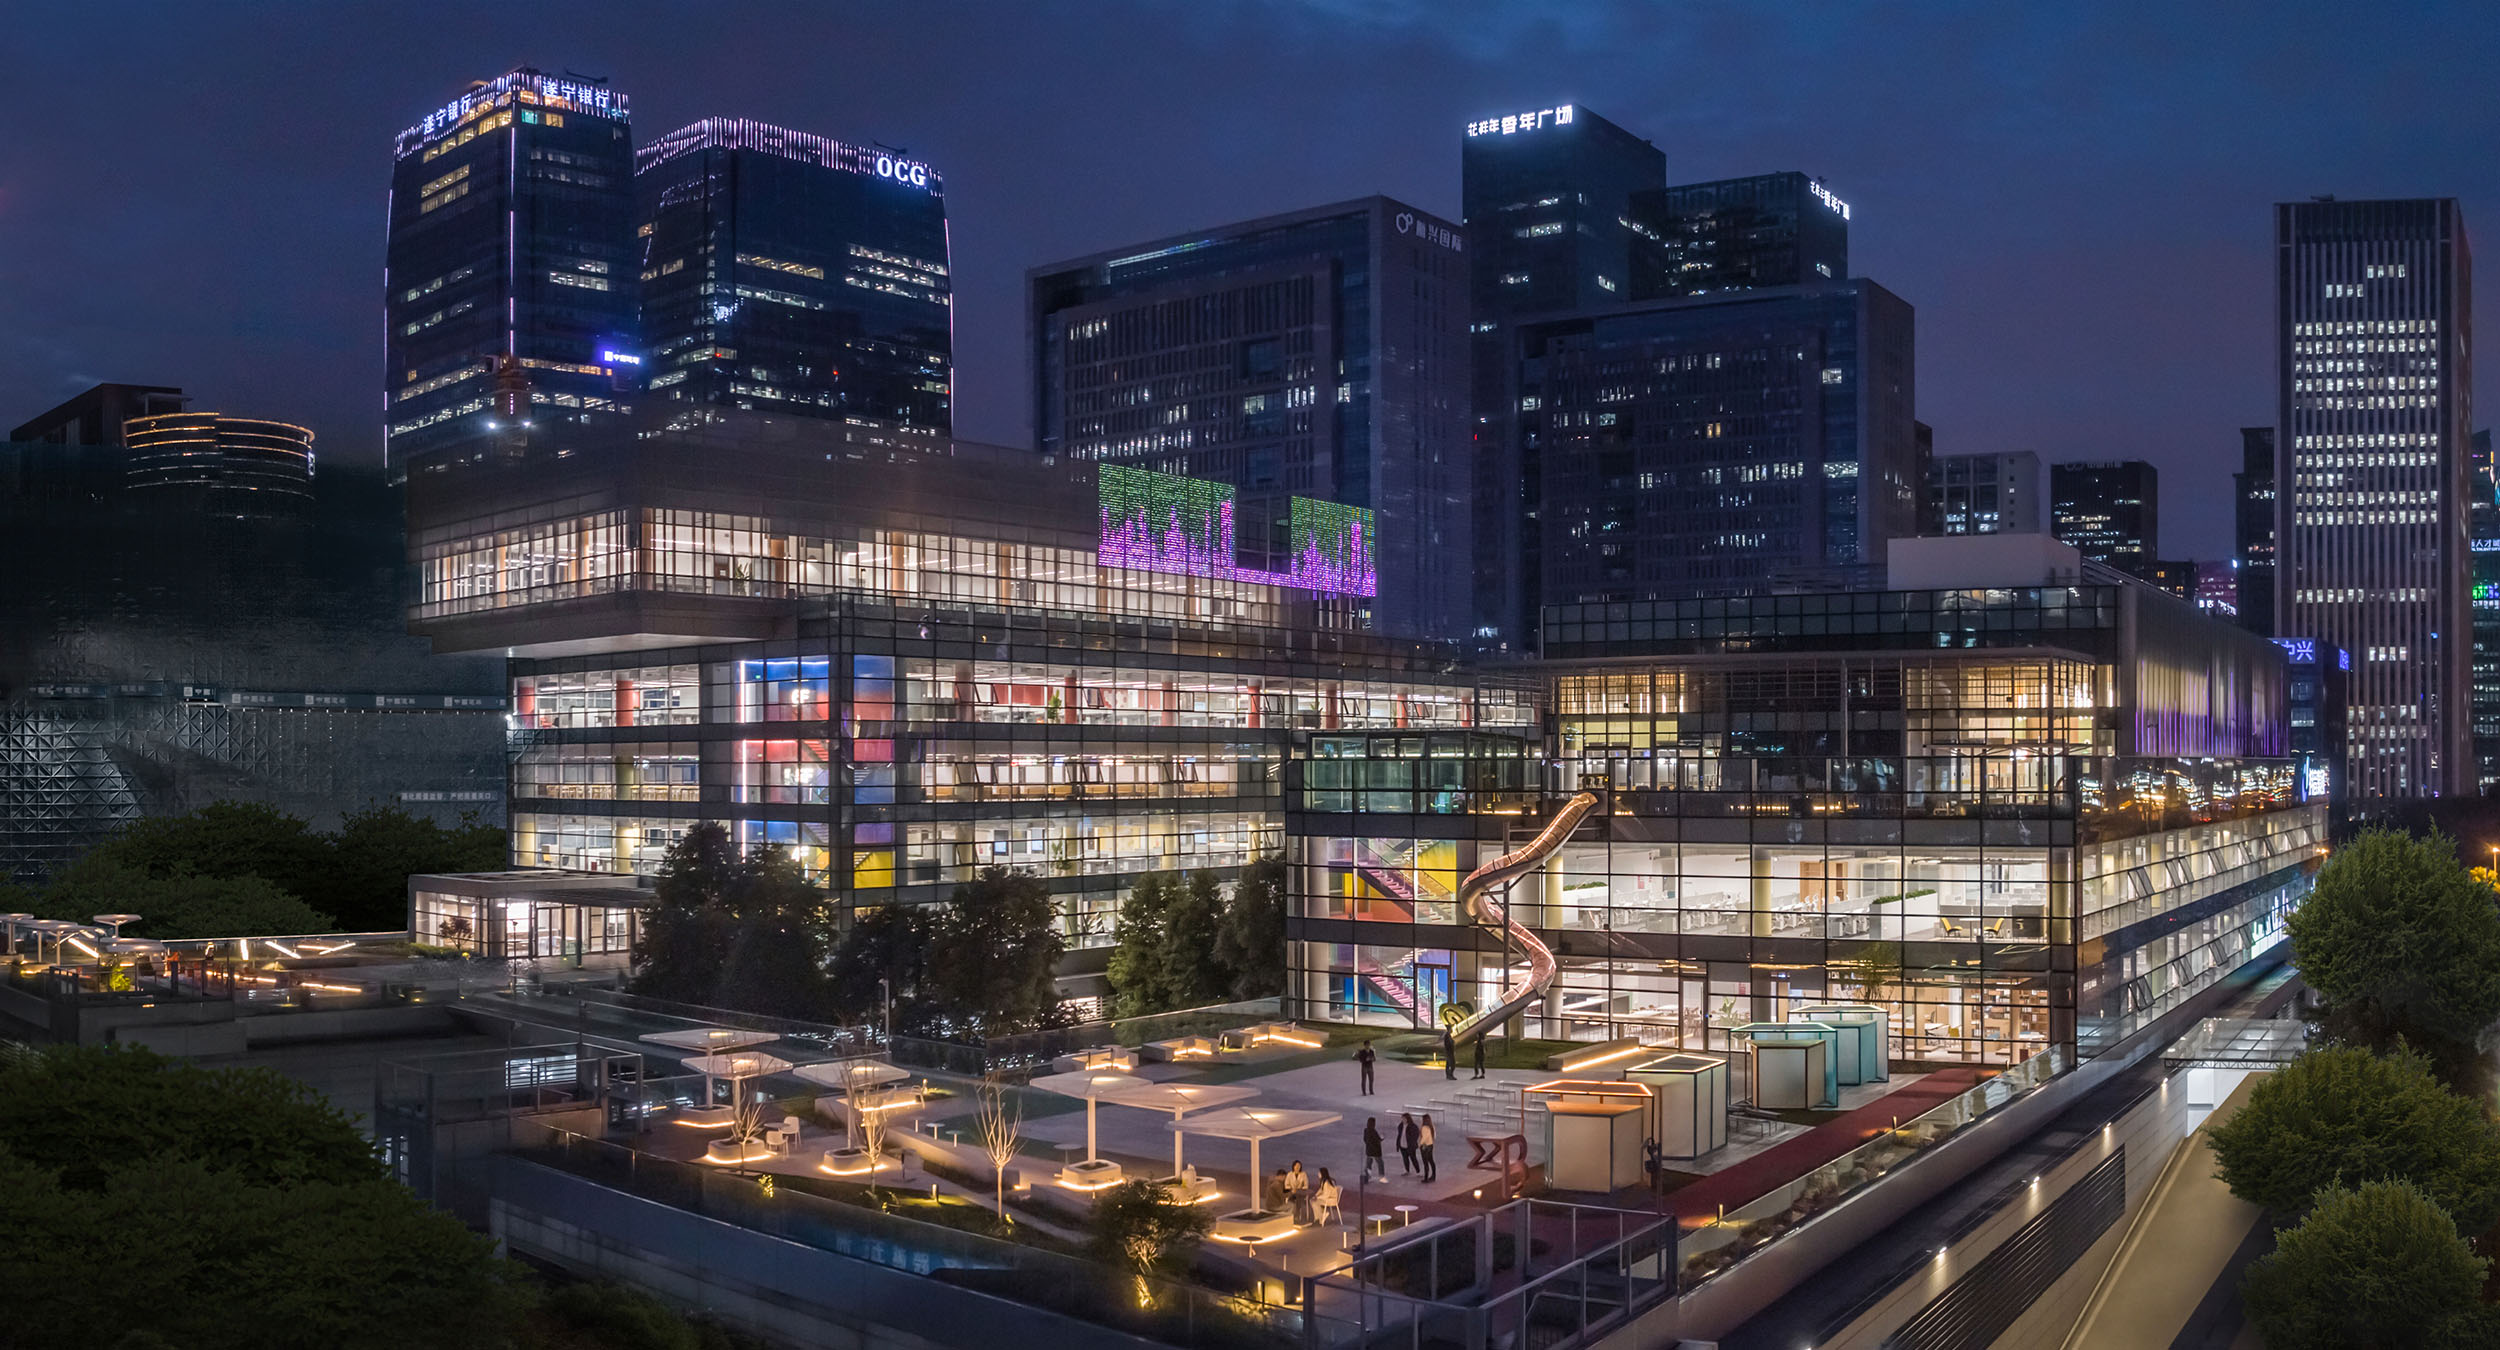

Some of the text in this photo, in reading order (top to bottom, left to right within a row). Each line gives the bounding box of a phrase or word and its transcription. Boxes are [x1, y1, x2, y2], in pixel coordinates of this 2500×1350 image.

[543, 80, 609, 108] 遂宁银行
[423, 93, 472, 135] 遂宁银行
[877, 157, 926, 186] OCG
